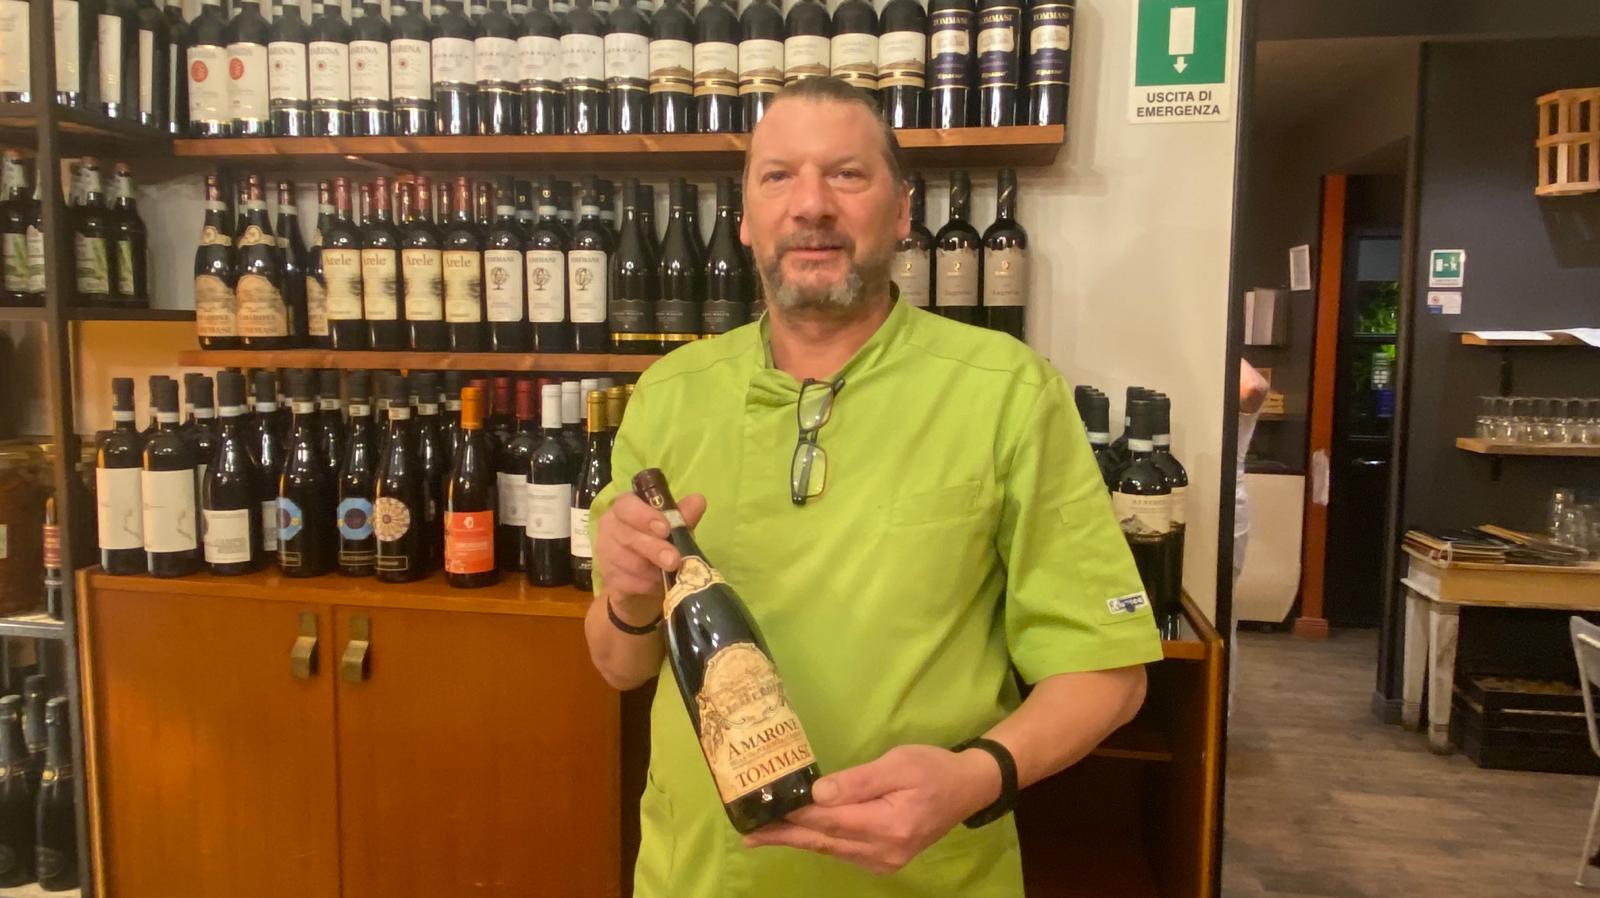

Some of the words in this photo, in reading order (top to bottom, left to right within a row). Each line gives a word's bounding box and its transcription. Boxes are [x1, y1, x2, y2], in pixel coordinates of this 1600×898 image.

[1147, 91, 1194, 103] USCITA
[1199, 90, 1212, 101] DI
[1136, 104, 1220, 117] EMERGENZA
[325, 253, 352, 266] Arele
[406, 254, 434, 266] Arele
[729, 718, 800, 761] AMARONE
[736, 743, 810, 788] TOMMASI
